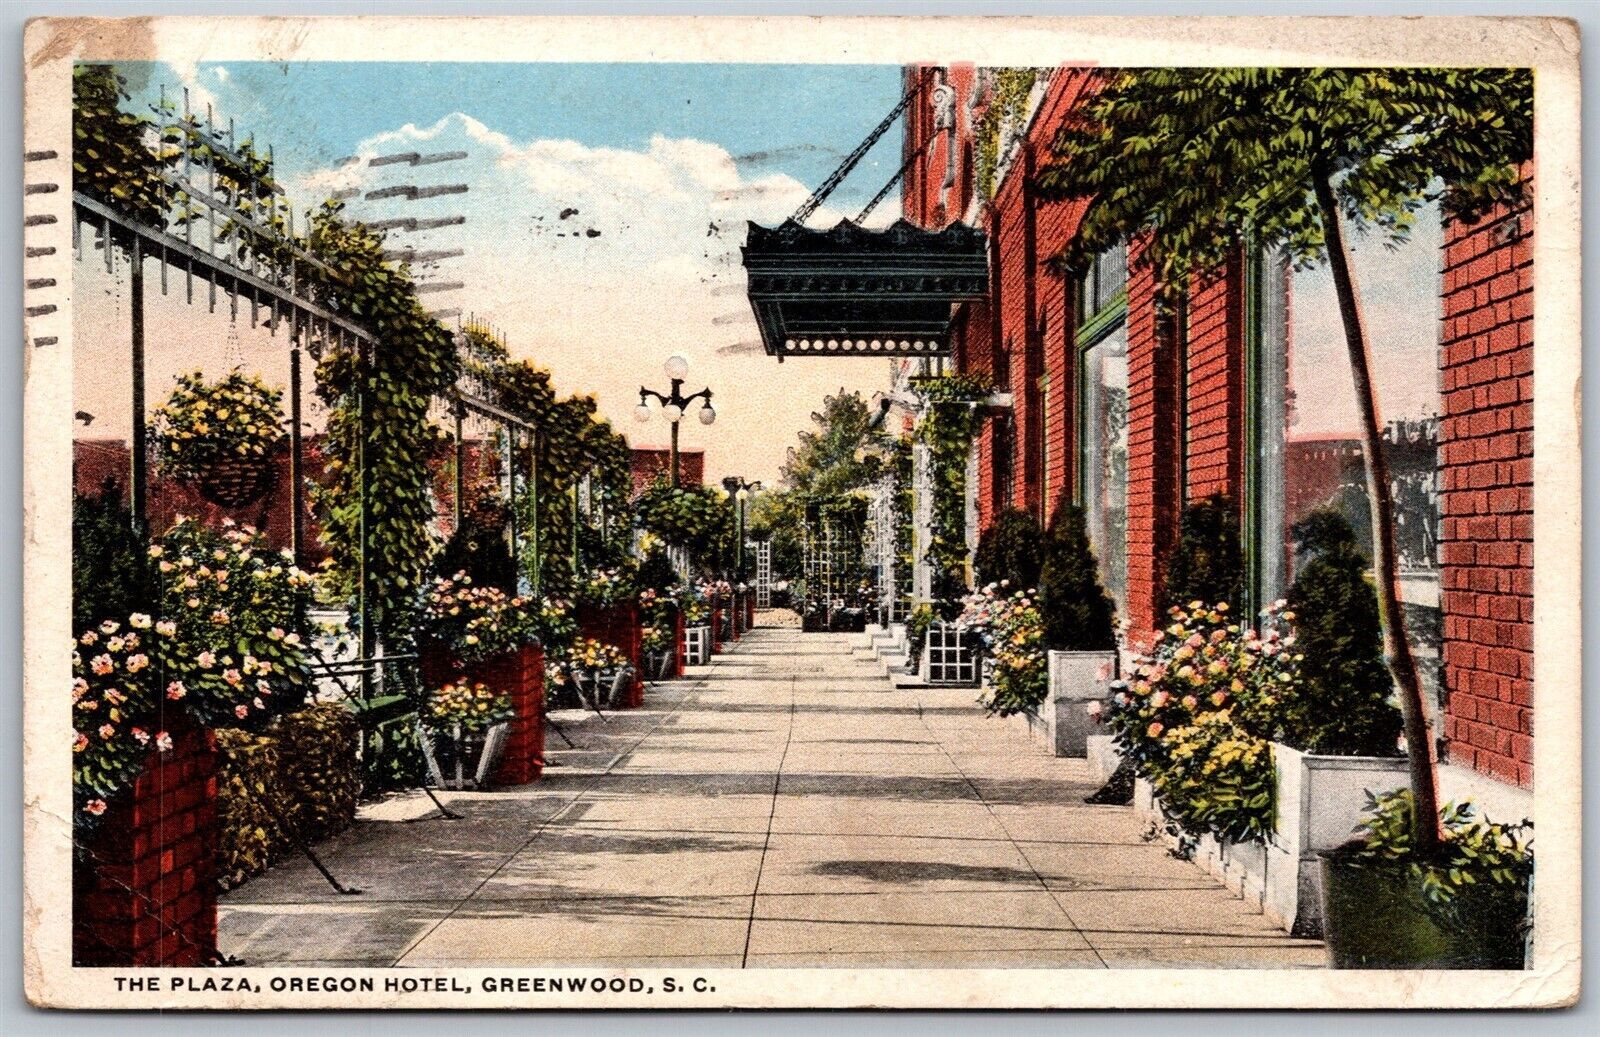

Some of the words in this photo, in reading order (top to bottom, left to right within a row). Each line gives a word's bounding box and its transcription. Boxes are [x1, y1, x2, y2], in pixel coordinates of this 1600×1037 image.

[114, 977, 160, 991] THE
[171, 977, 260, 993] PLAZA,
[270, 976, 373, 992] OREGON
[385, 977, 471, 993] HOTEL,
[482, 977, 653, 994] GREENWOOD,
[663, 977, 684, 992] S.
[693, 977, 715, 992] C.
